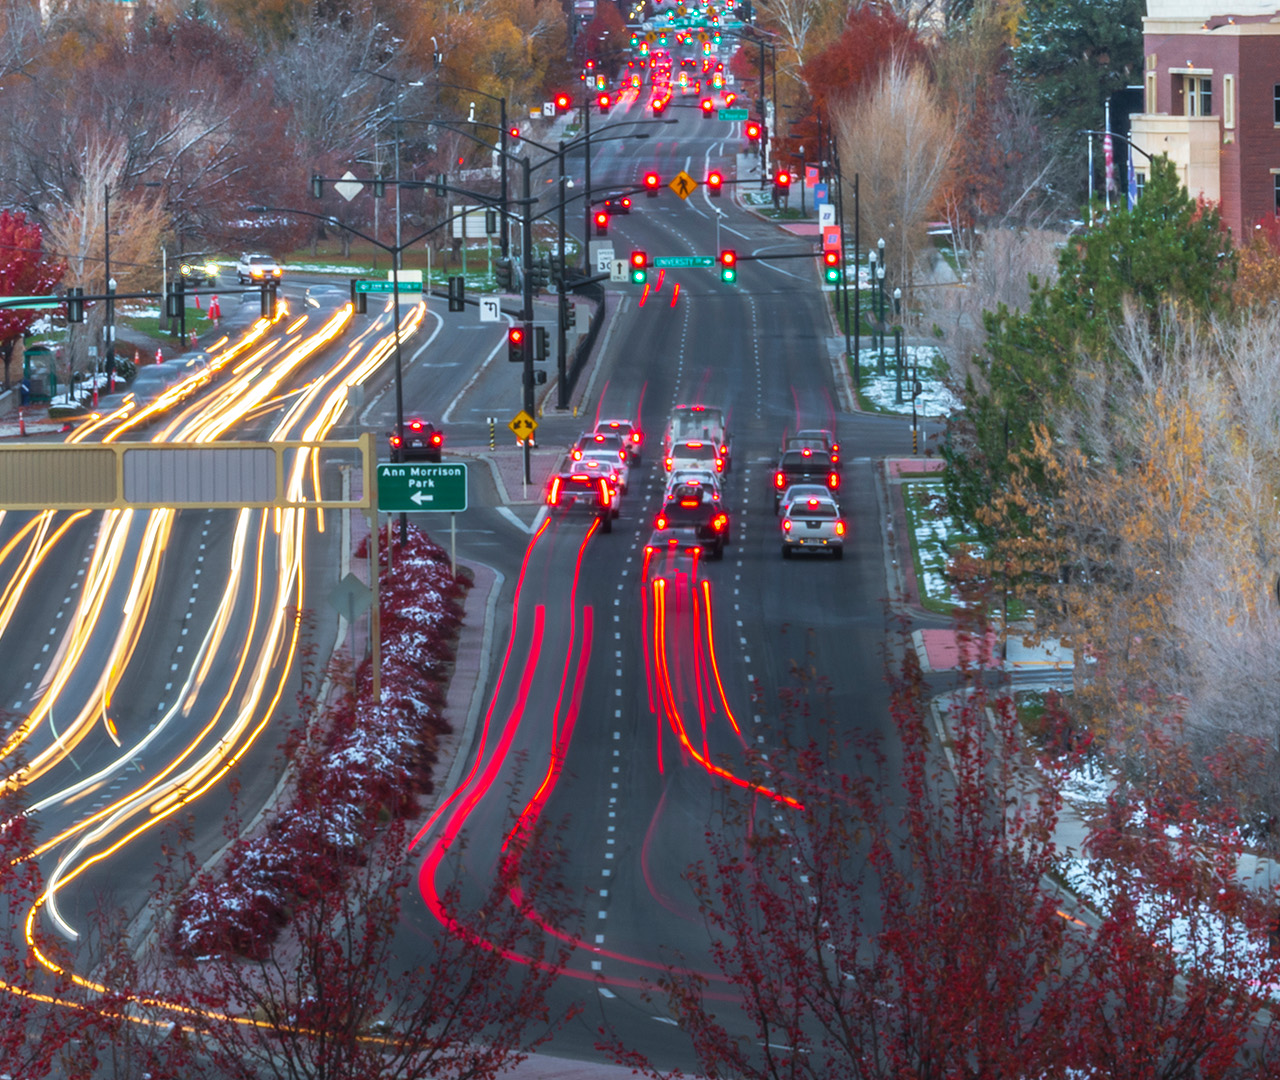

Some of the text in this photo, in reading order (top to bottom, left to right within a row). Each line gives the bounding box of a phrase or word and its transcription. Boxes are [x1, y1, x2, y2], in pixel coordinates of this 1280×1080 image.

[656, 258, 693, 266] UNIVERSITY
[382, 467, 461, 476] Ann Morrison
[408, 478, 435, 488] Park
